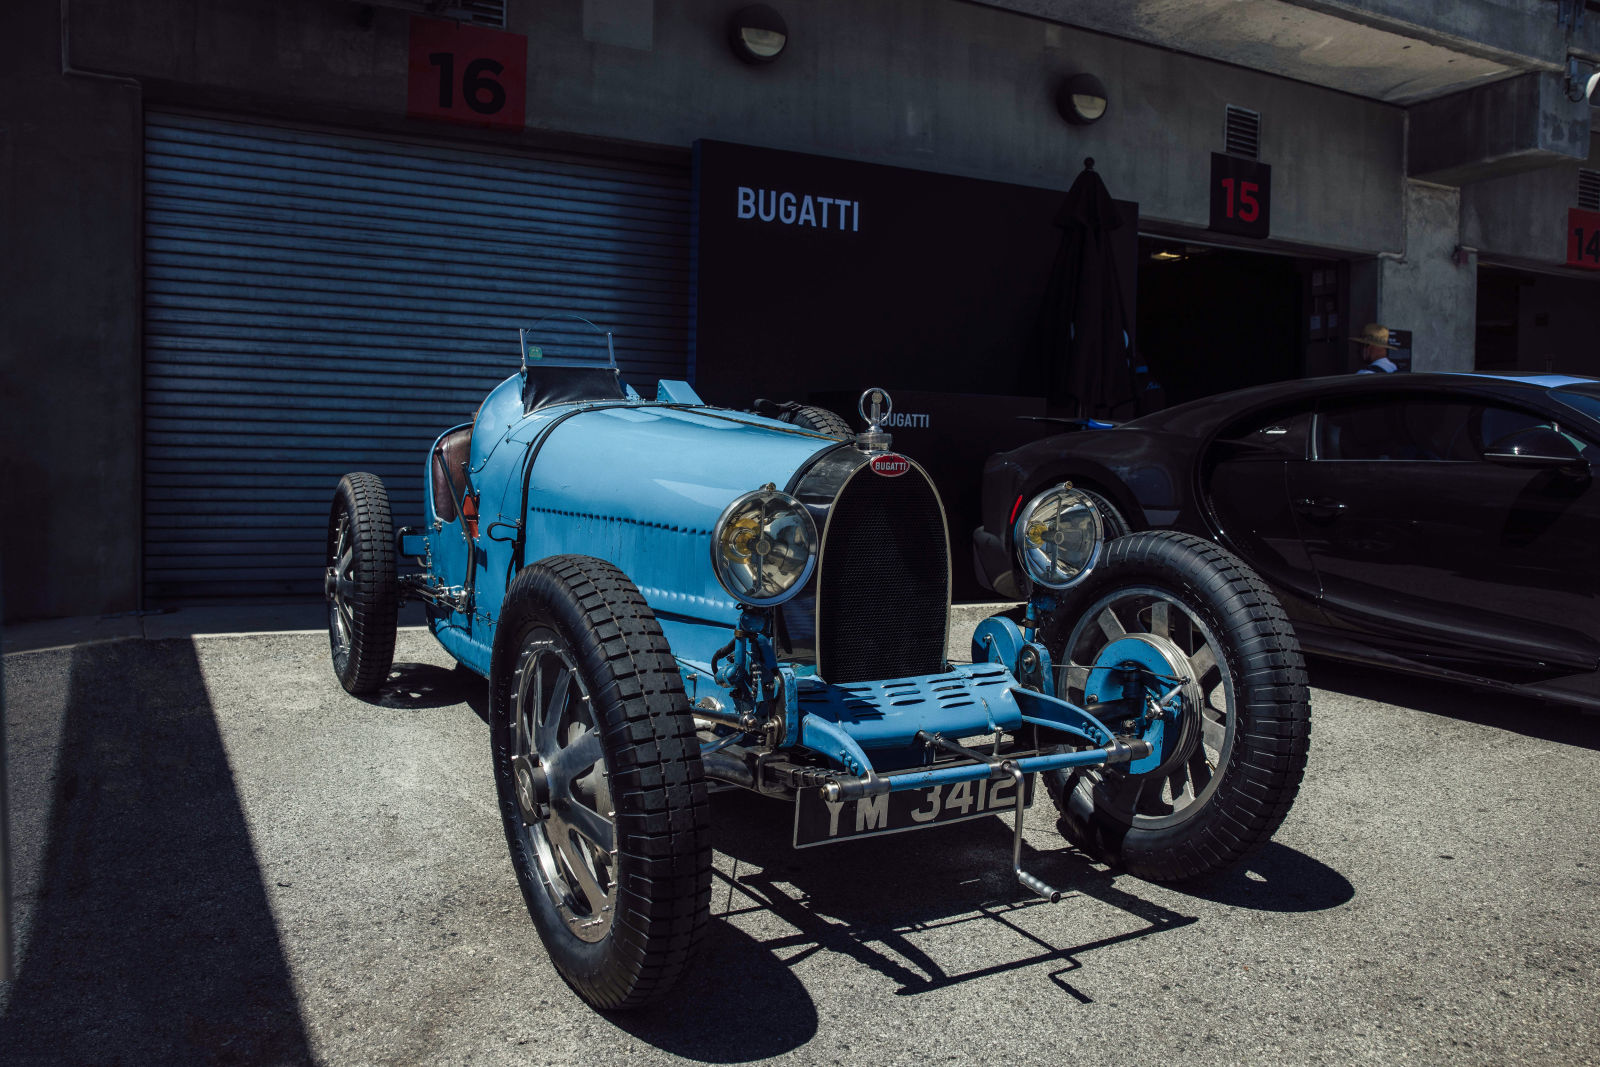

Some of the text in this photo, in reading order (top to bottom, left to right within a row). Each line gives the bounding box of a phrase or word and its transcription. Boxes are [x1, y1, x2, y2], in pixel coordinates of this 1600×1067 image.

[429, 52, 506, 114] 16
[737, 186, 860, 232] BUGATTI
[1221, 178, 1260, 223] 15
[1574, 228, 1600, 264] 14
[880, 412, 930, 429] BUGATTI
[875, 461, 907, 471] BUGATTI
[825, 775, 1017, 836] YM 3412
